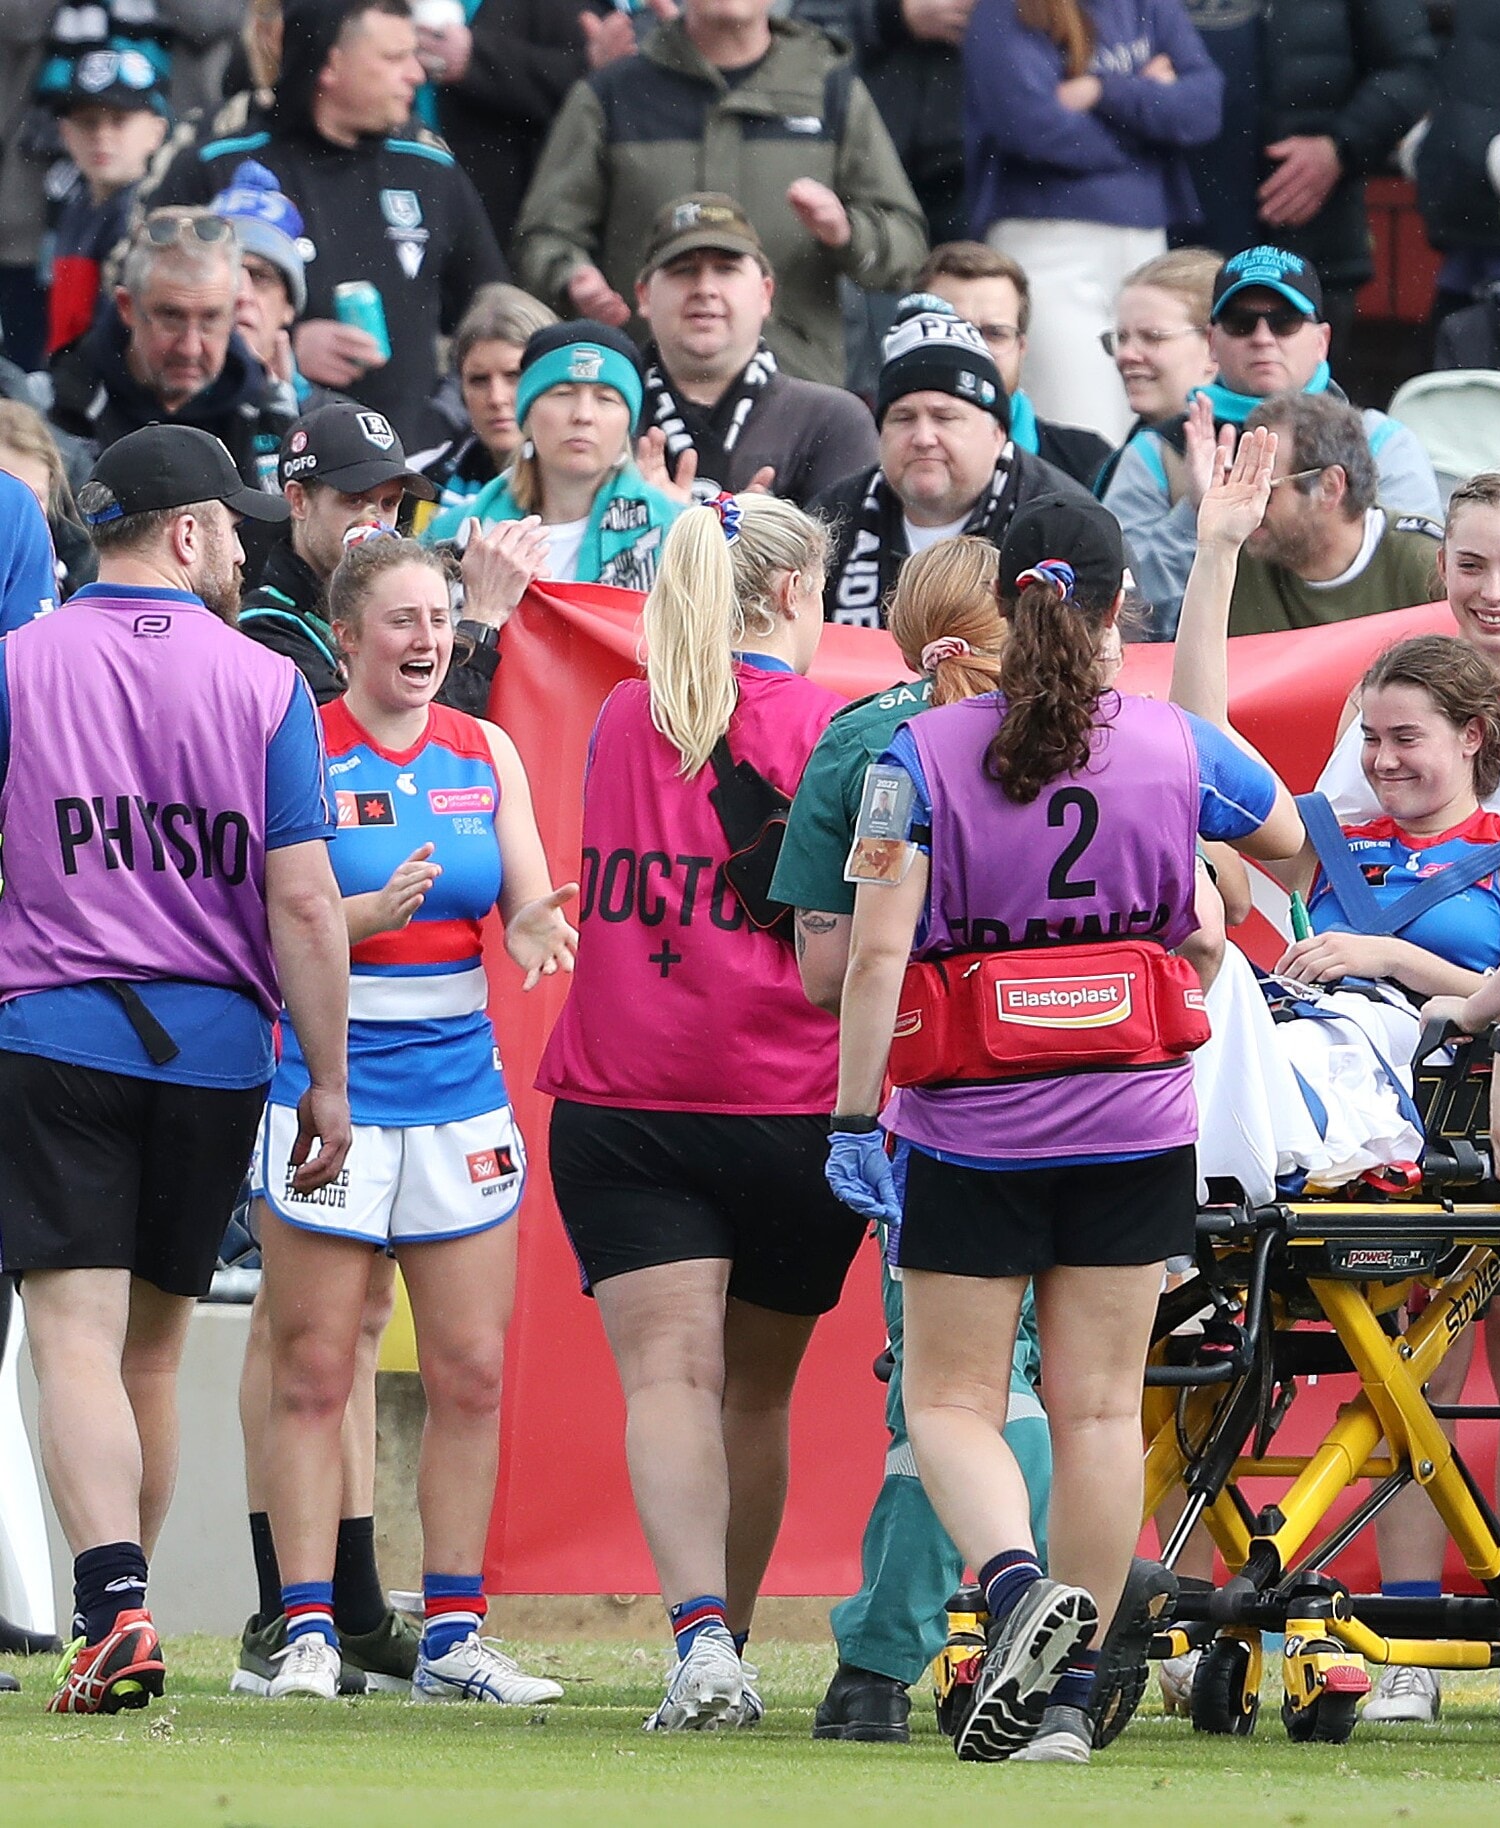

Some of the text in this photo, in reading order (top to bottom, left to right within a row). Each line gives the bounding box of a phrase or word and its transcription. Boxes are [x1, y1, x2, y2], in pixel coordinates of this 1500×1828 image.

[55, 796, 250, 886] PHYSIO
[1047, 786, 1099, 899] 2
[580, 847, 758, 935] OCTO
[1008, 985, 1118, 1008] Elastoplast
[1347, 1250, 1392, 1267] power
